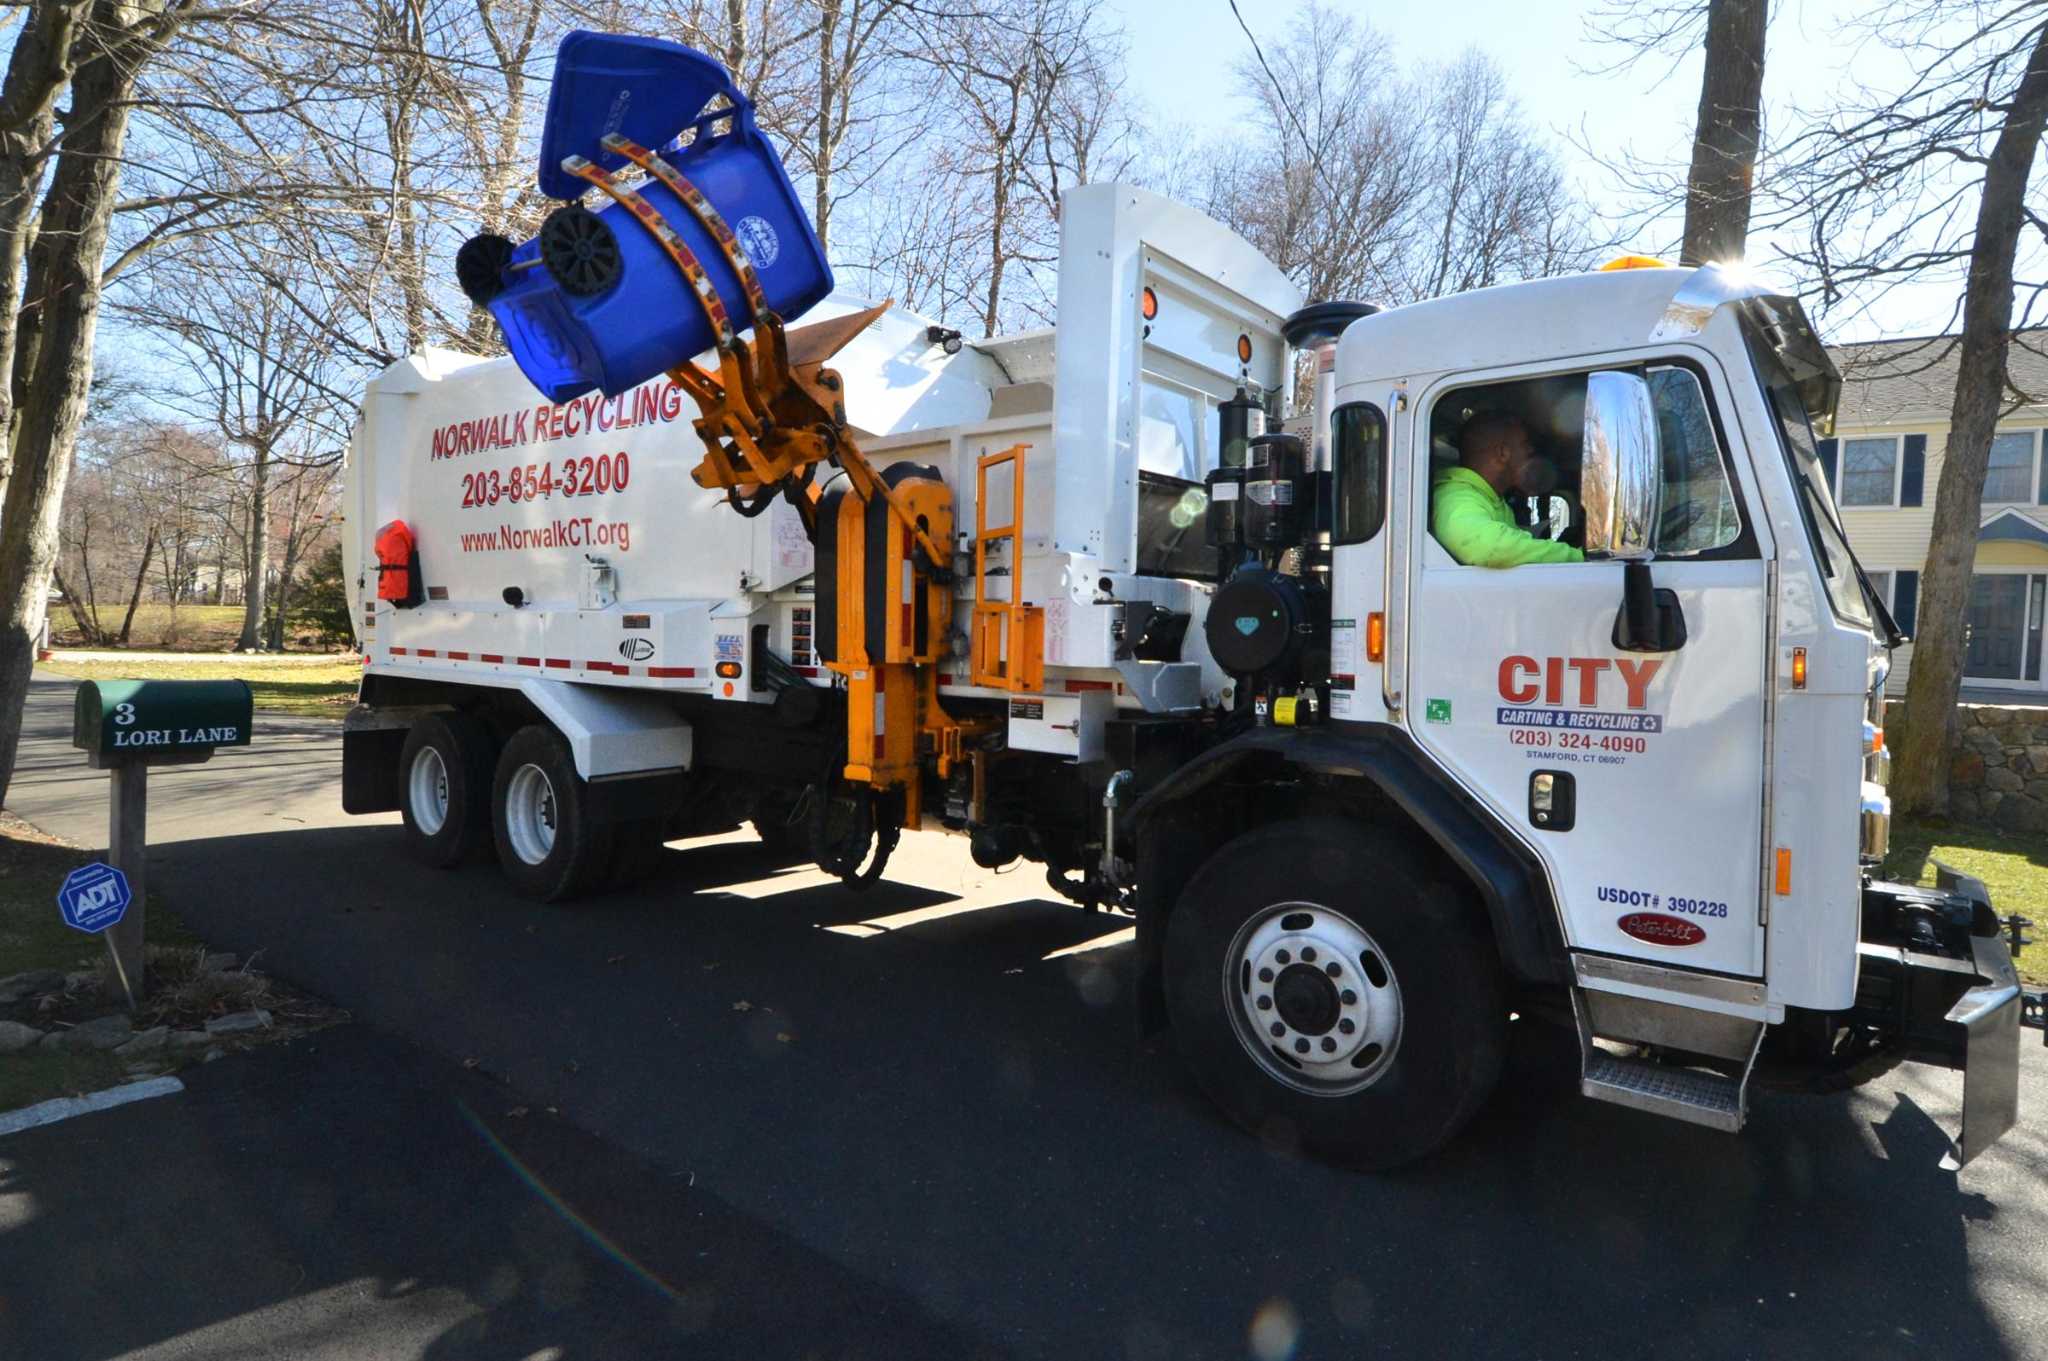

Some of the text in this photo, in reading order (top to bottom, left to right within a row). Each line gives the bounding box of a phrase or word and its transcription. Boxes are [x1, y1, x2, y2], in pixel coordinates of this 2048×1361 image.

[431, 378, 682, 461] NORWALK RECYCLING
[461, 452, 630, 509] 203-854-3200
[460, 517, 630, 552] www.NorwalkCT.org
[1498, 655, 1663, 710] CITY
[115, 702, 136, 725] 3
[1501, 709, 1639, 730] CARTING & RECYCLING
[114, 727, 237, 747] LORI LANE
[1509, 728, 1646, 754] (203) 324-4090
[1526, 750, 1581, 763] STAMFORD,
[1583, 754, 1596, 763] CT
[77, 878, 117, 916] ADT
[1597, 886, 1728, 918] USDOT# 390228
[1627, 915, 1698, 940] Peterbilt
